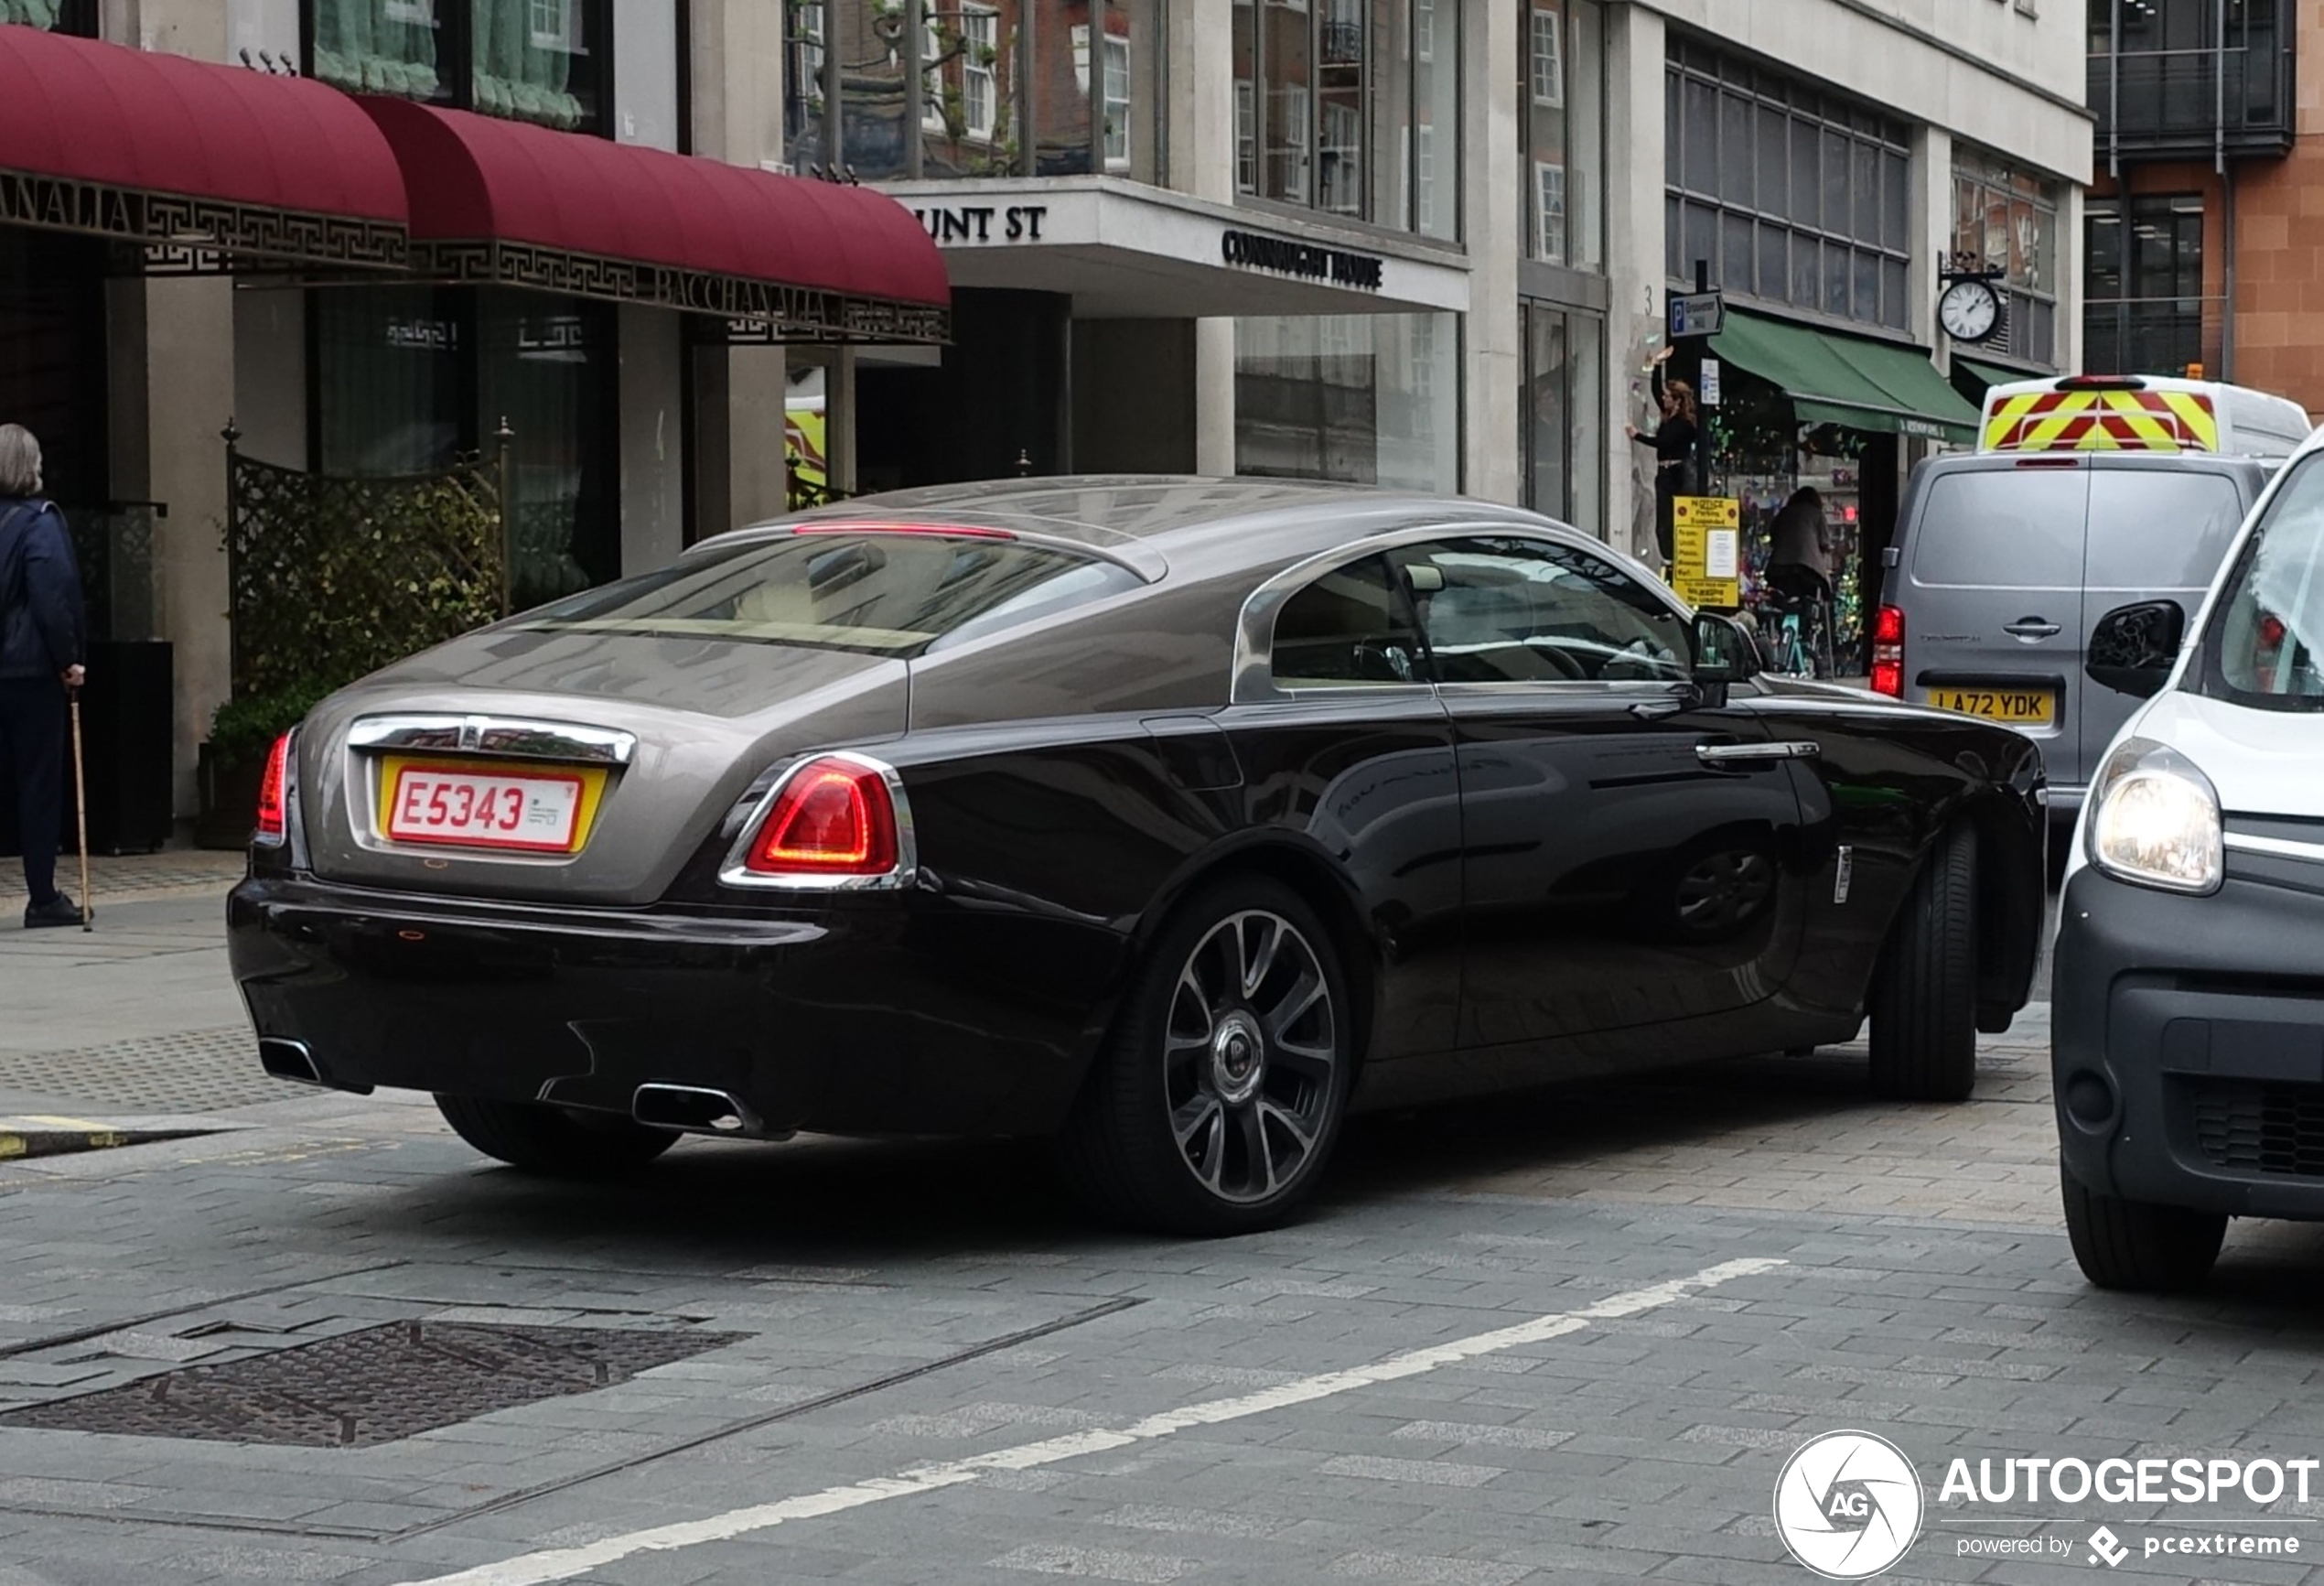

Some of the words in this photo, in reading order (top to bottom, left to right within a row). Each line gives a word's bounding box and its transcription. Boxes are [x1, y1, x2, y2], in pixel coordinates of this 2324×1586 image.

[1005, 206, 1047, 239] ST
[655, 267, 827, 325] BACCHANALIA
[1644, 285, 1652, 316] 3
[1674, 305, 1683, 330] P
[1691, 500, 1724, 509] NOTICE
[2000, 694, 2042, 716] YDK
[401, 782, 524, 831] E5343
